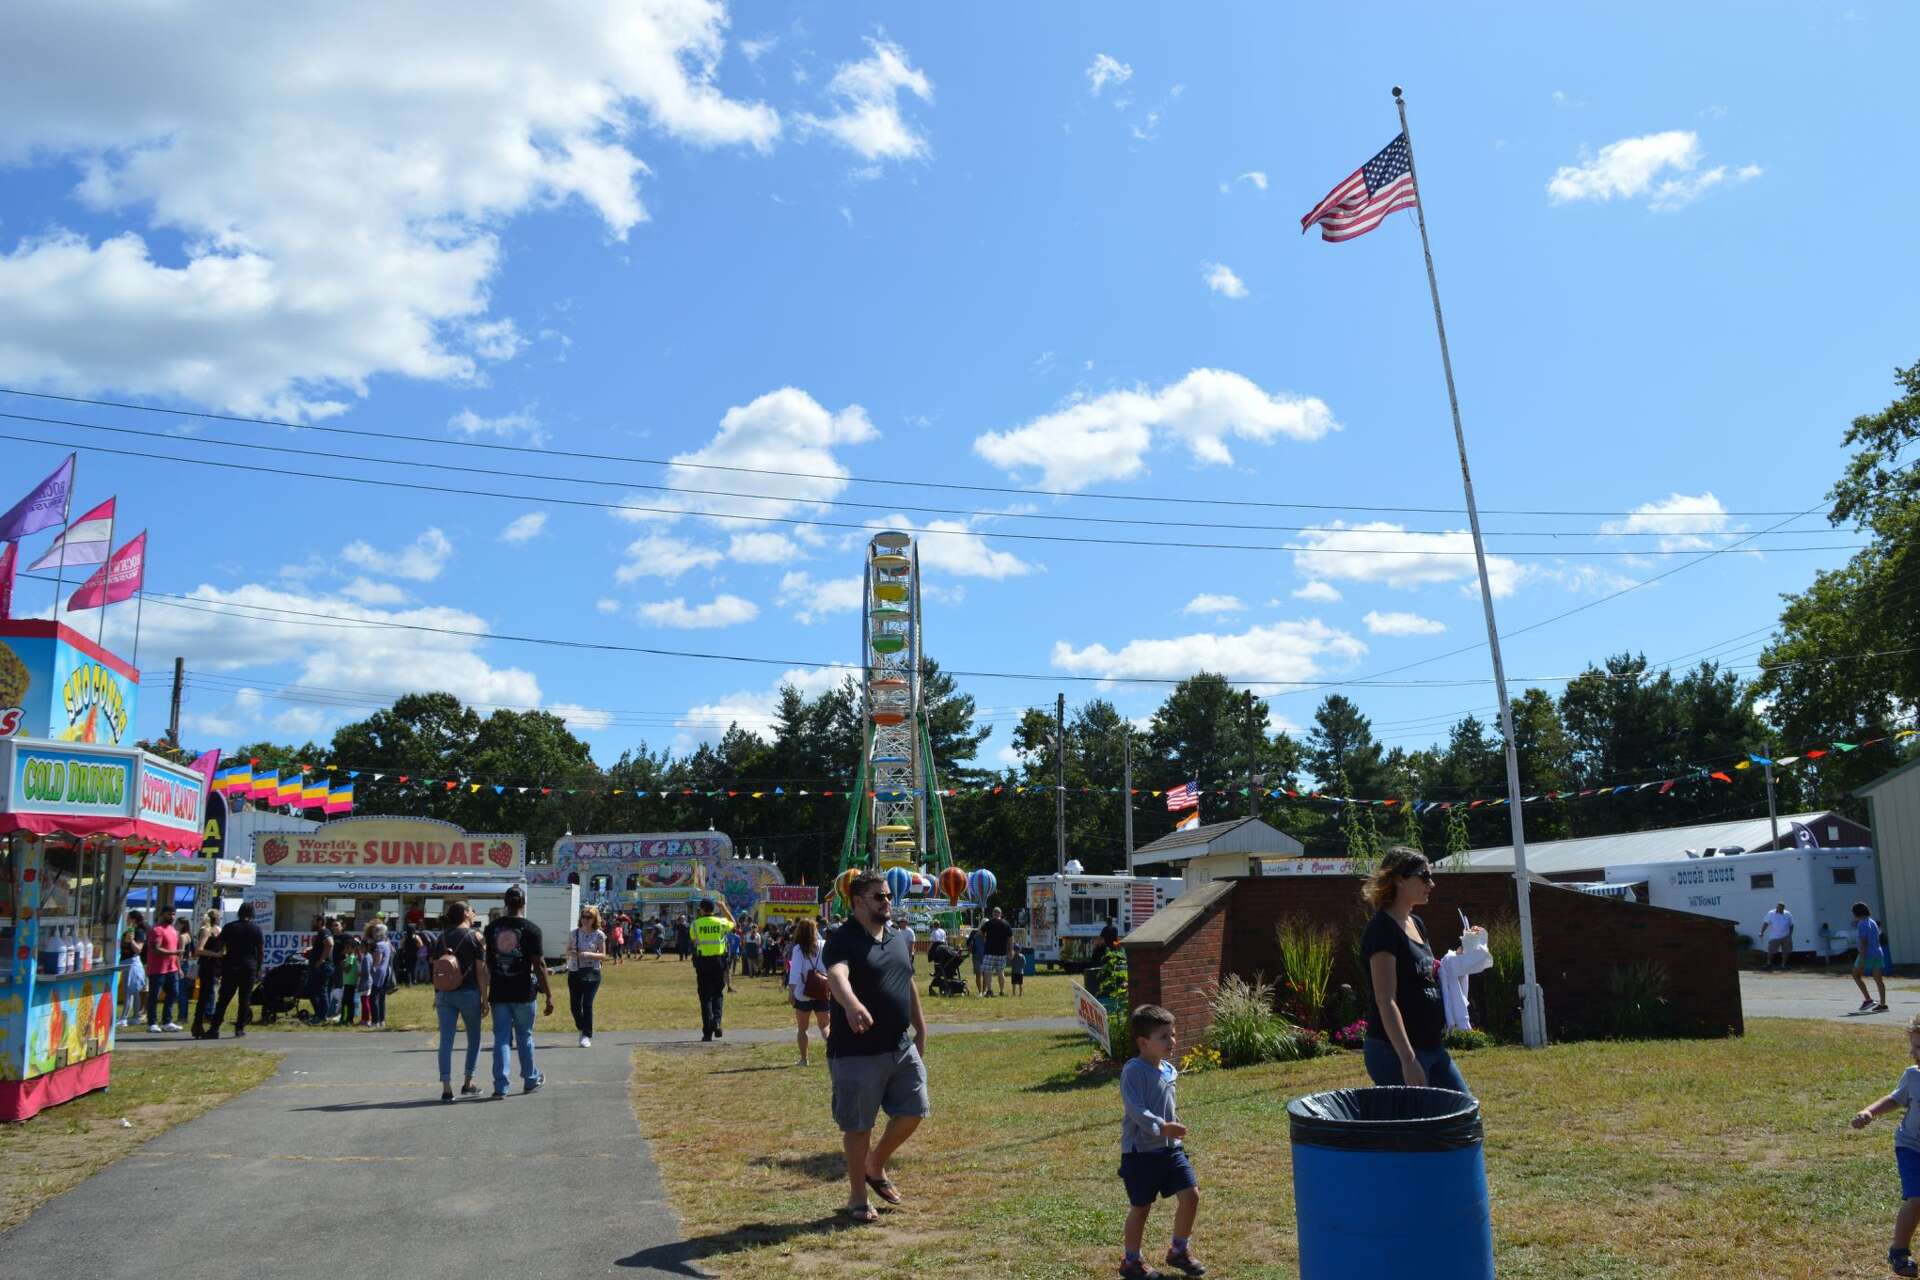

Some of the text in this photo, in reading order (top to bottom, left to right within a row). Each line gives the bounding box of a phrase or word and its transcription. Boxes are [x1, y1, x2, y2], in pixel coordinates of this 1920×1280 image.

[24, 759, 124, 805] COLD DRINKS
[142, 772, 199, 821] COTTON CANDY
[297, 839, 358, 850] World's
[363, 840, 485, 865] SUNDAE
[577, 839, 705, 858] MARDI GRAS
[296, 850, 359, 865] BEST
[1677, 870, 1704, 885] DOUGH
[1707, 867, 1735, 883] HOUSE
[338, 882, 465, 891] WORLD'S BEST Sundae
[699, 925, 721, 934] POLICE
[264, 934, 299, 948] RLD'S
